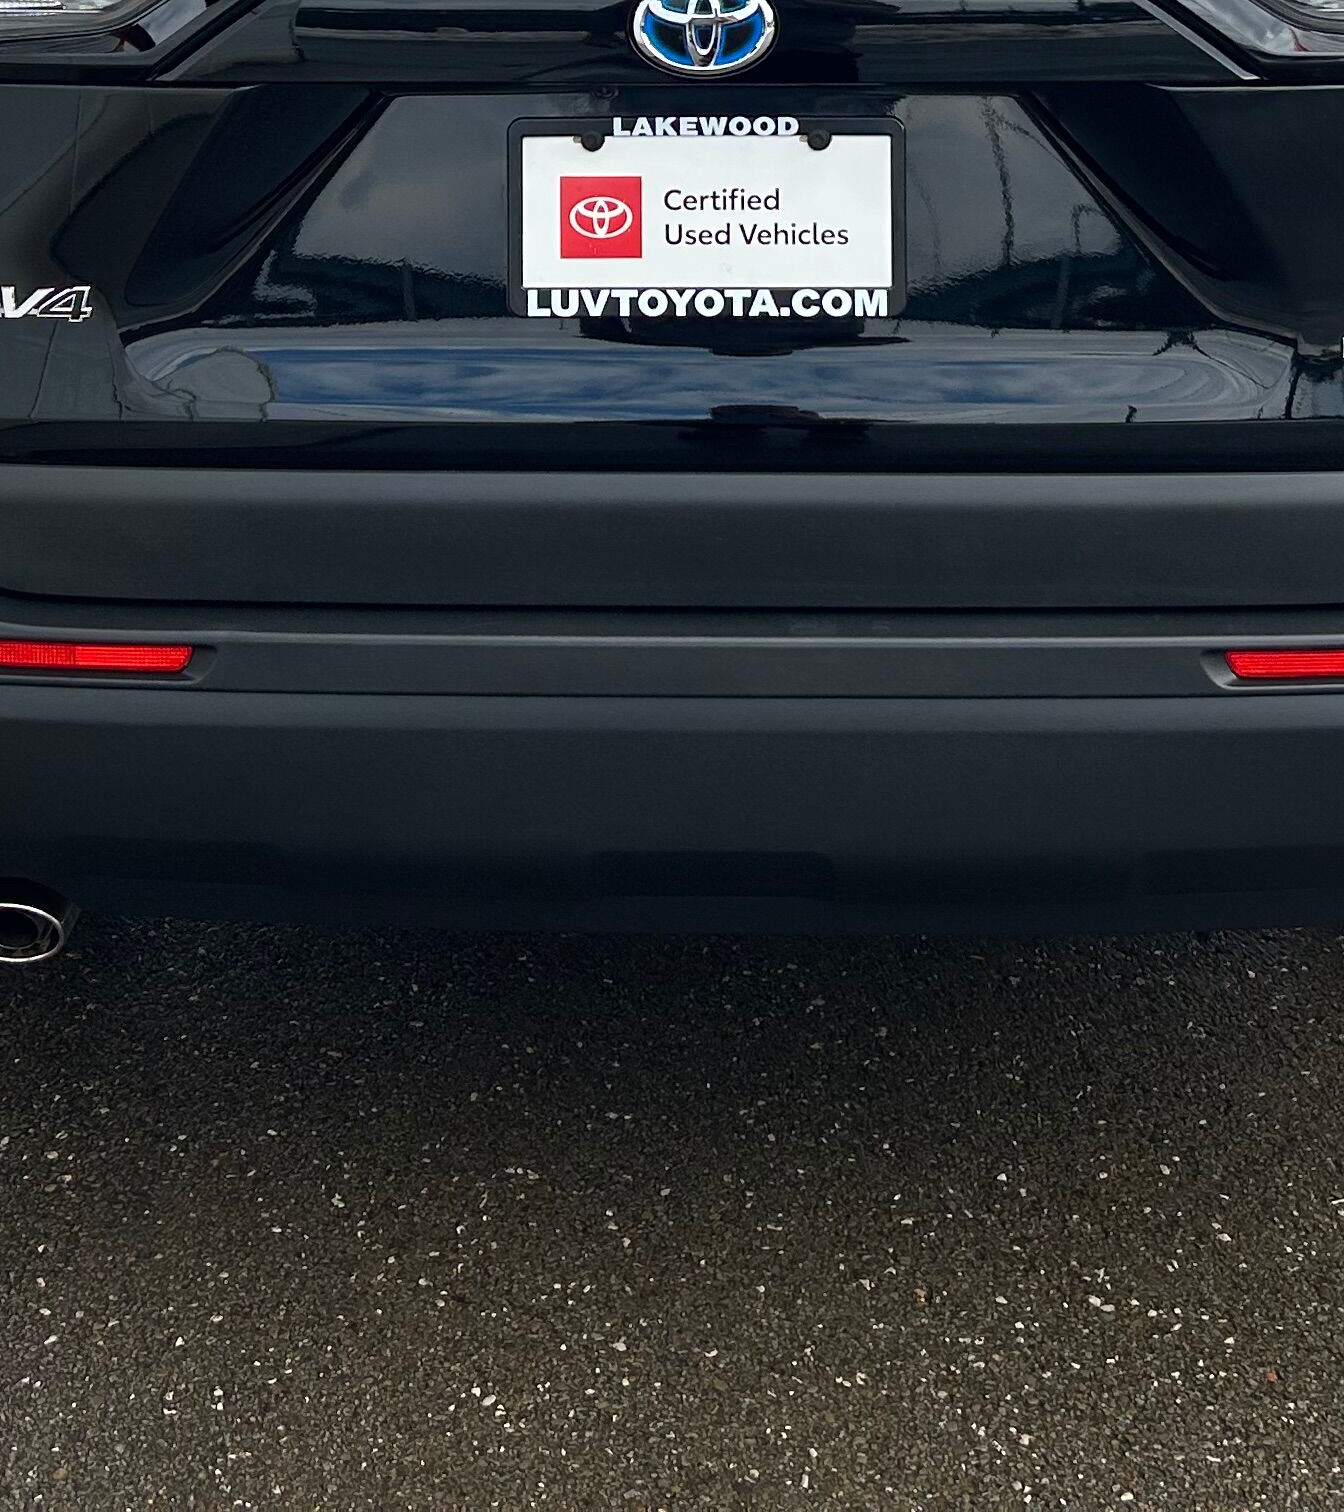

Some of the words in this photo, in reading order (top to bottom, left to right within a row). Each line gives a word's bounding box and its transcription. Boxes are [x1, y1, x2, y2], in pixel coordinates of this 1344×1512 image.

[612, 116, 800, 137] LAKEWOOD
[664, 188, 781, 211] Certified
[665, 223, 731, 246] Used
[739, 222, 849, 246] Vehicles
[527, 288, 888, 318] LUVTOYOTA.COM
